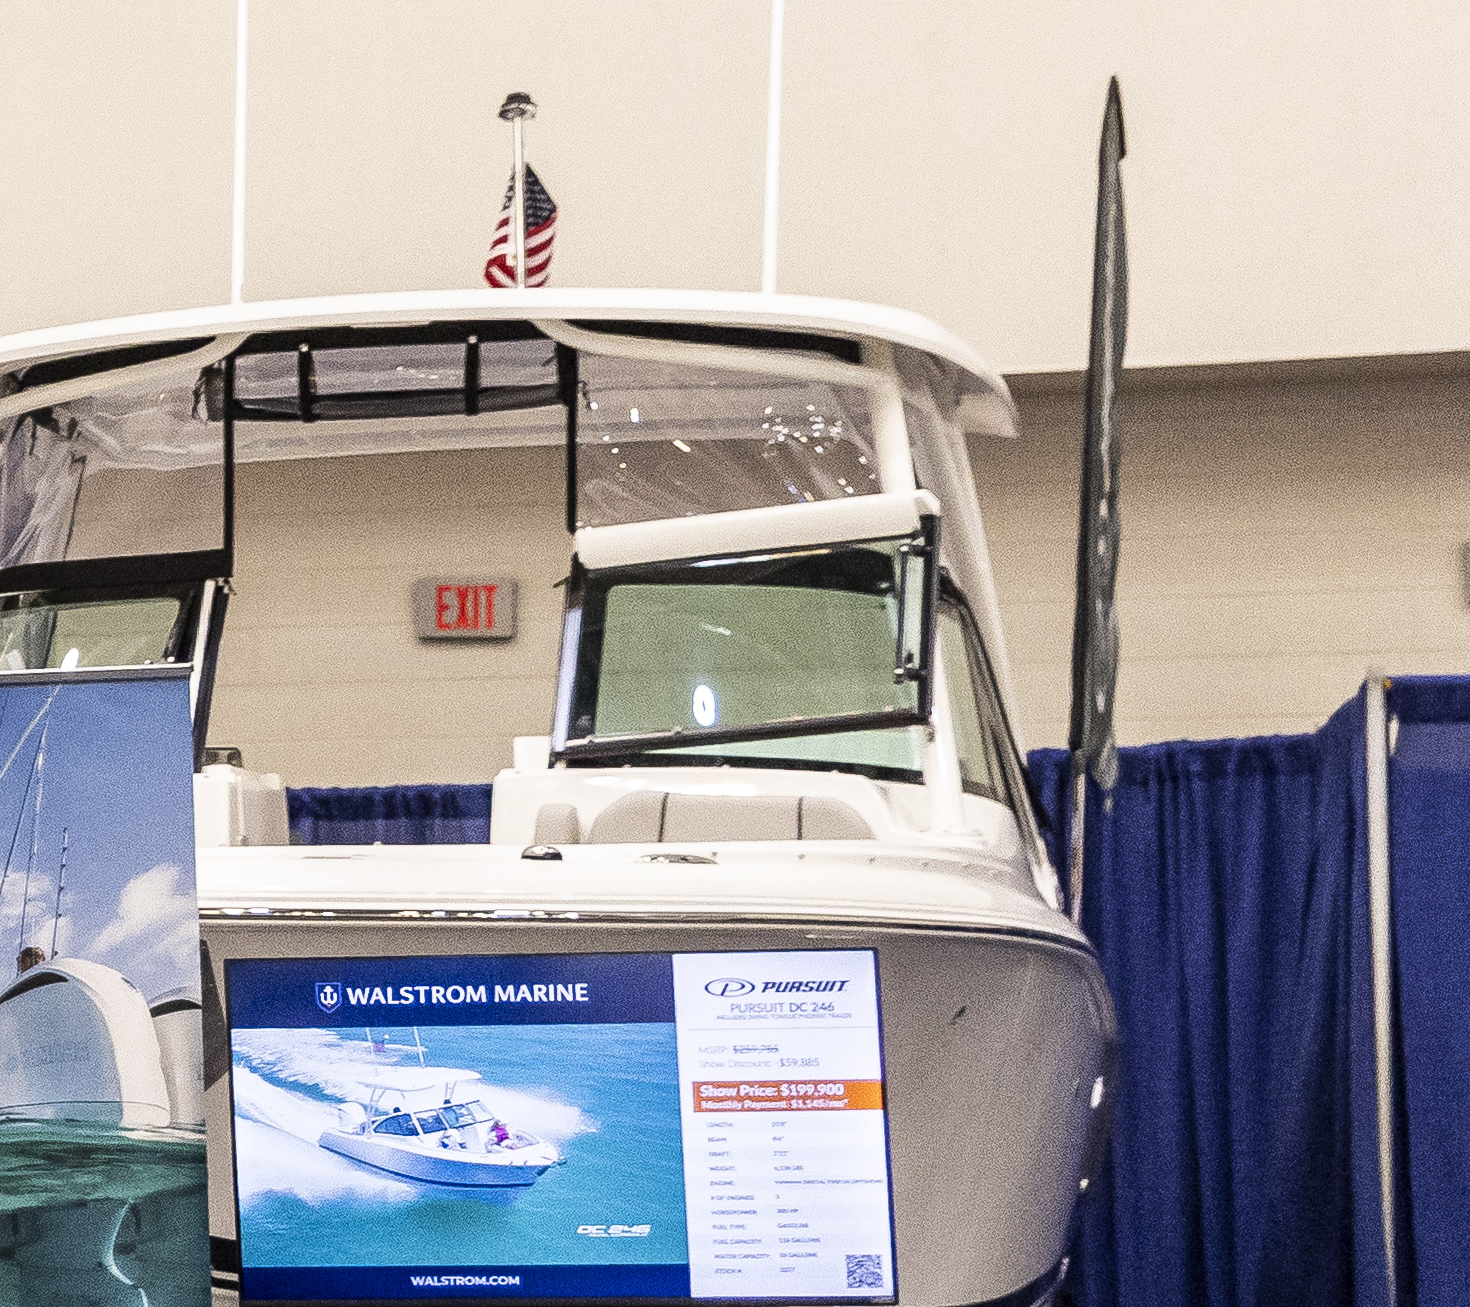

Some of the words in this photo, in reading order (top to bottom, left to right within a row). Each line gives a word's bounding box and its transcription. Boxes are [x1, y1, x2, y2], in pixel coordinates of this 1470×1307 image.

[435, 584, 498, 630] EXIT
[346, 985, 488, 1006] WALSTROM
[494, 982, 590, 1003] MARINE
[761, 979, 851, 994] PURSUIT
[730, 1002, 785, 1014] PURSUIT
[788, 1002, 808, 1013] DC
[811, 1001, 835, 1013] 246
[699, 1085, 738, 1098] Show
[779, 1083, 845, 1097] $199,900
[410, 1275, 521, 1286] WALSTROM.COM
